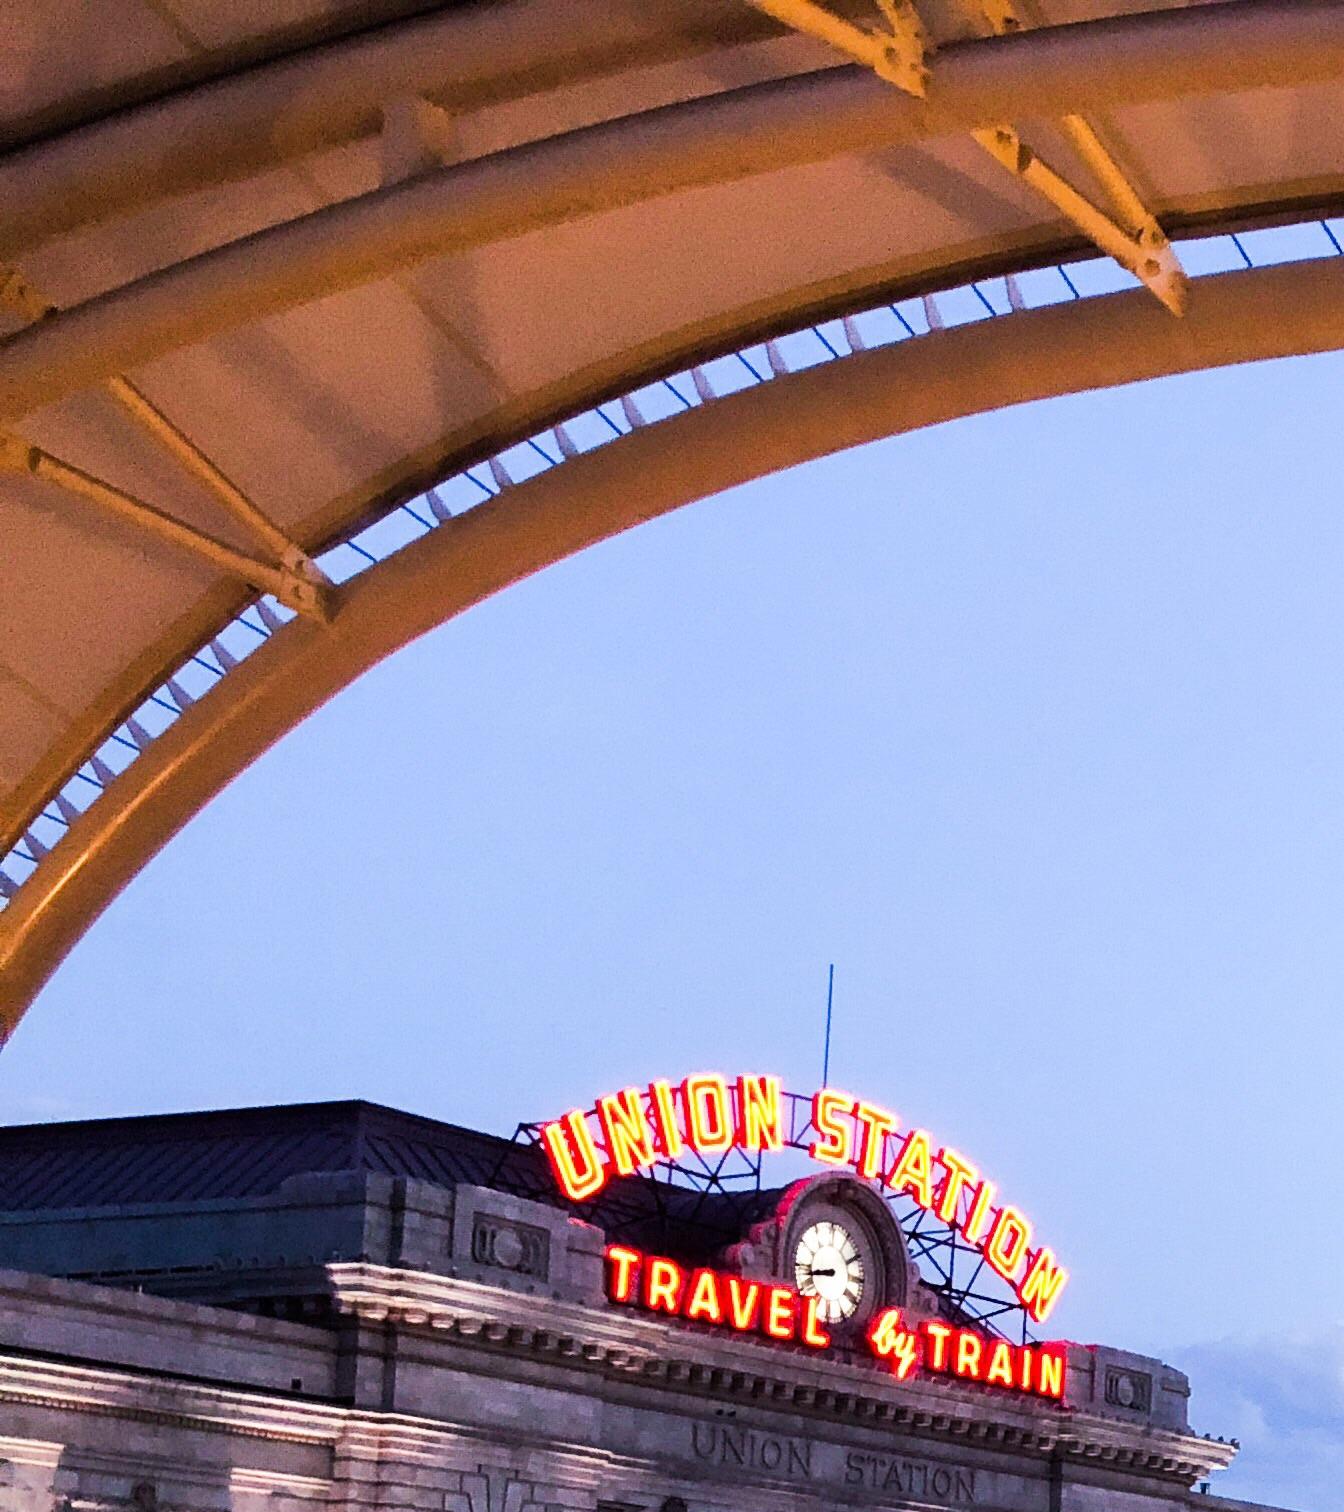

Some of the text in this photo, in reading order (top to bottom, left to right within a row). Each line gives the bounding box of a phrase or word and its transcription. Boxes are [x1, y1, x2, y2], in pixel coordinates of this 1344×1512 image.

[540, 1072, 1068, 1324] UNION STATION
[603, 1244, 1066, 1401] TRAVEL by TRAIN
[690, 1420, 978, 1501] UNION STATION
